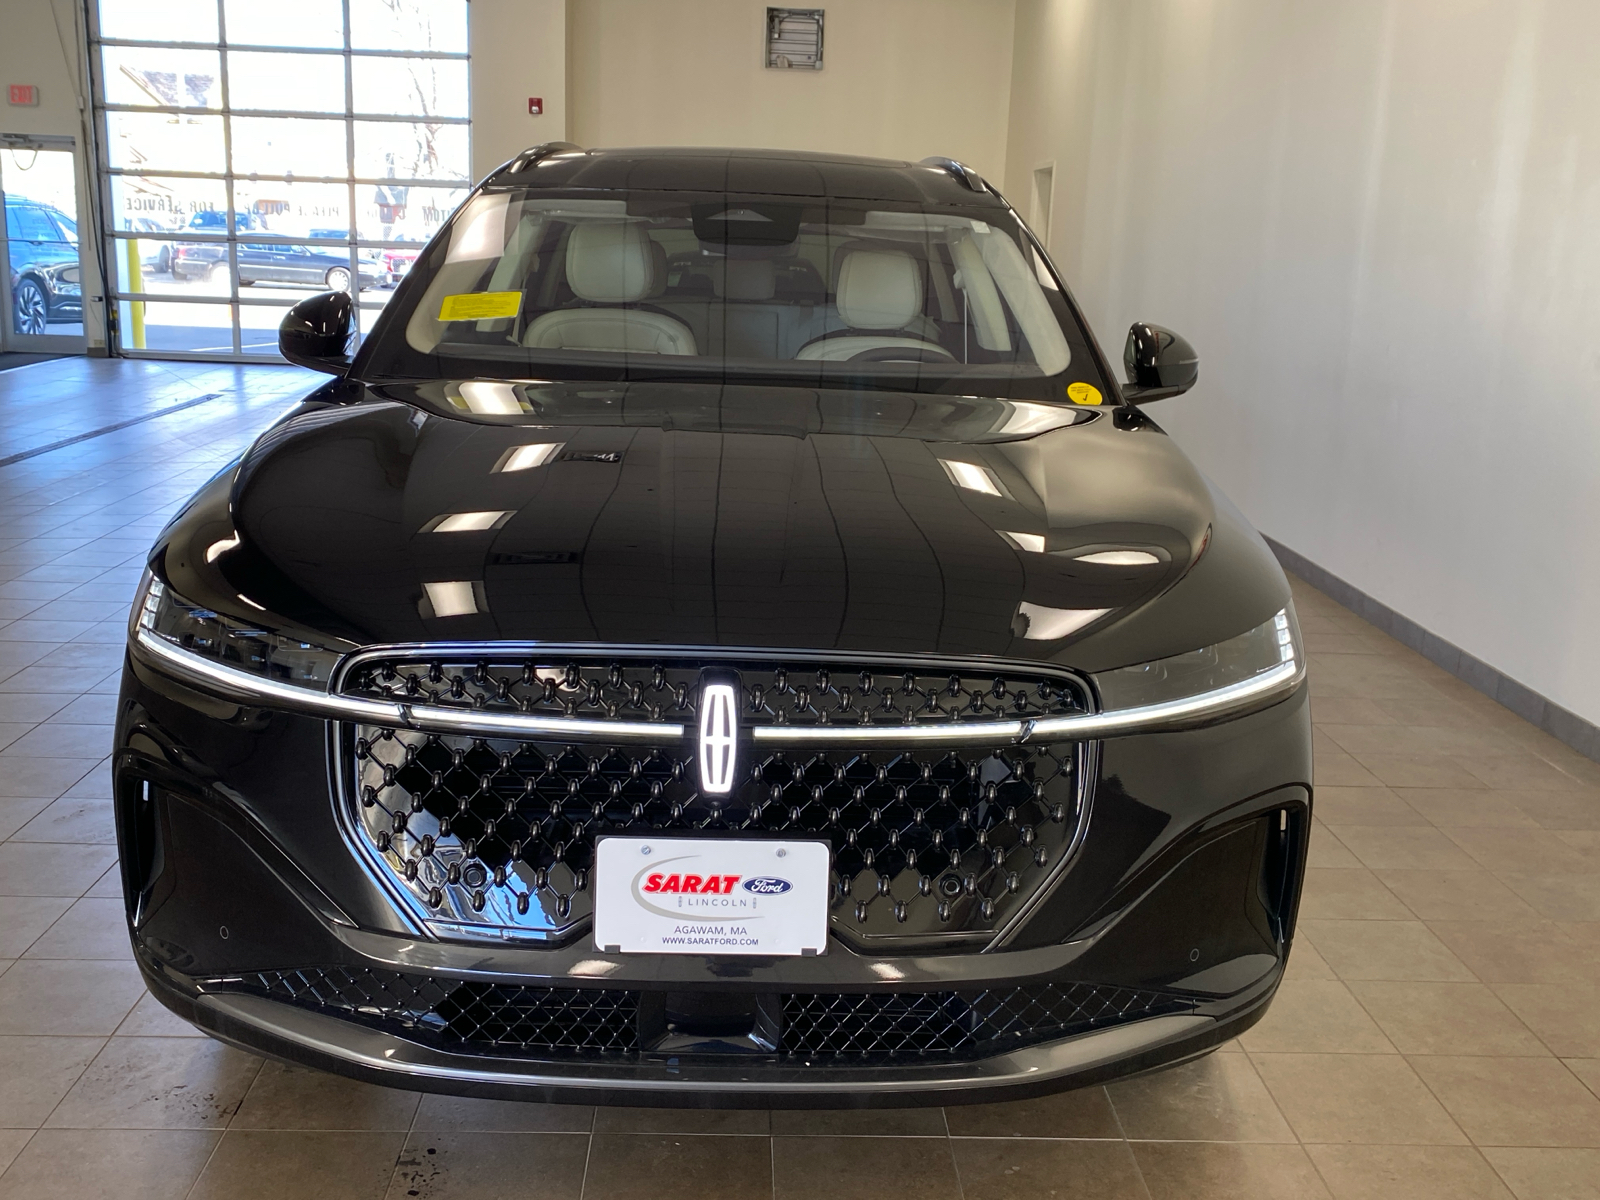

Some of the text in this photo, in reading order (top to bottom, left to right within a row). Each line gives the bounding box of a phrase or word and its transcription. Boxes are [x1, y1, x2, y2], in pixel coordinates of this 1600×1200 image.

[10, 85, 32, 103] EXIT
[642, 872, 742, 895] SARAT
[688, 898, 747, 907] LINCOLN
[674, 925, 748, 936] AGAWAM, MA
[662, 937, 759, 946] WWW.SARATFORD.COM
